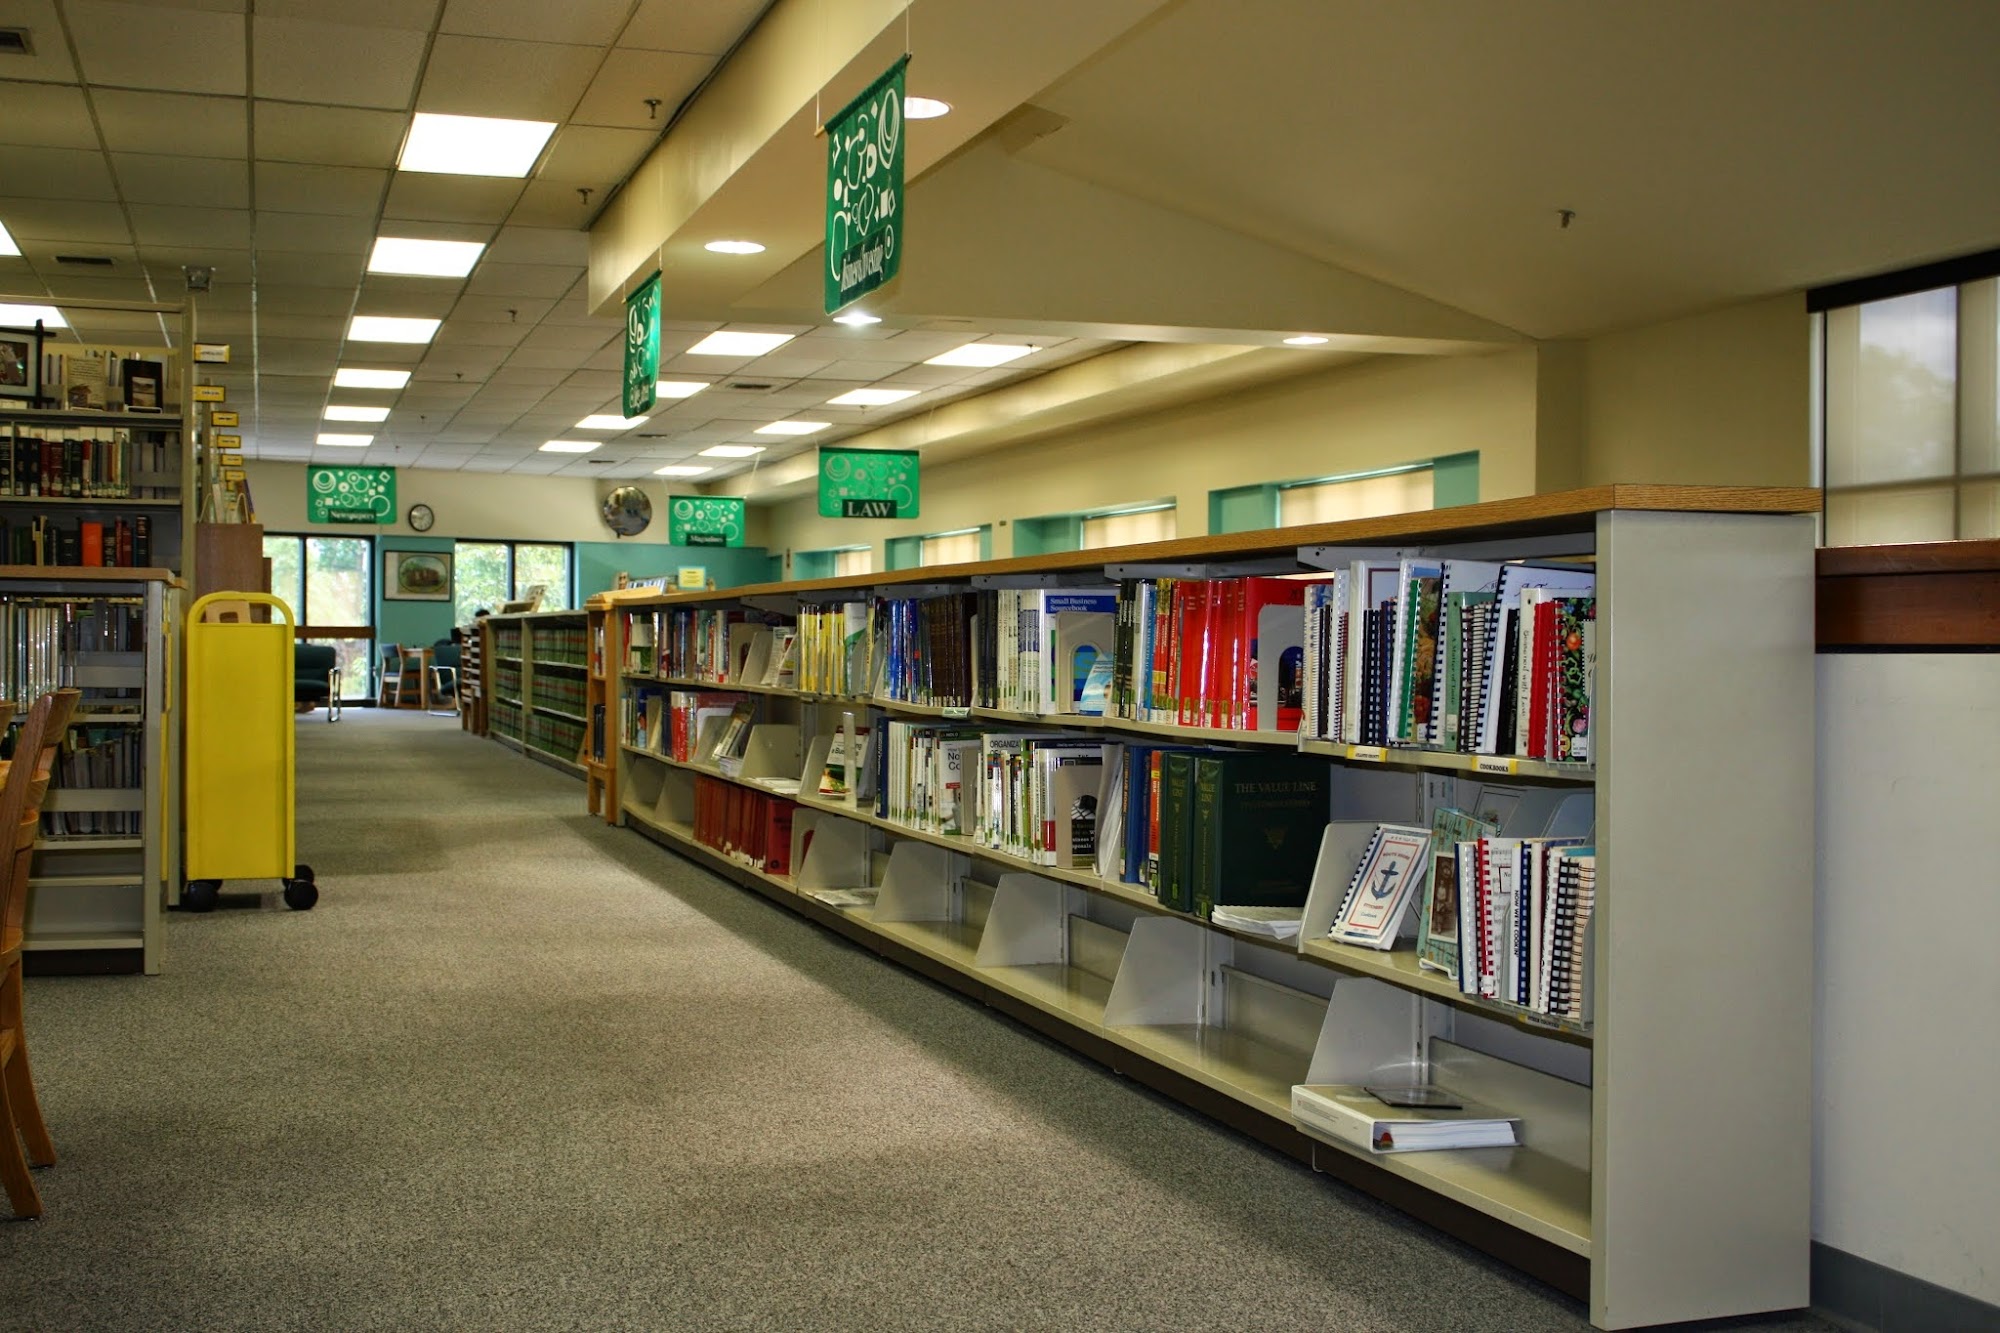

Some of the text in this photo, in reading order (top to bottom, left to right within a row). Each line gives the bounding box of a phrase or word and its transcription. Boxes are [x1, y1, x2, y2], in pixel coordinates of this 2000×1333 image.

[847, 501, 891, 517] LAW
[1522, 630, 1530, 671] Seasoned
[1520, 696, 1528, 716] Love
[989, 740, 1019, 749] ORGANIZA
[1479, 763, 1509, 773] COOKBOOKS
[1234, 781, 1318, 793] THE VALUE LINE
